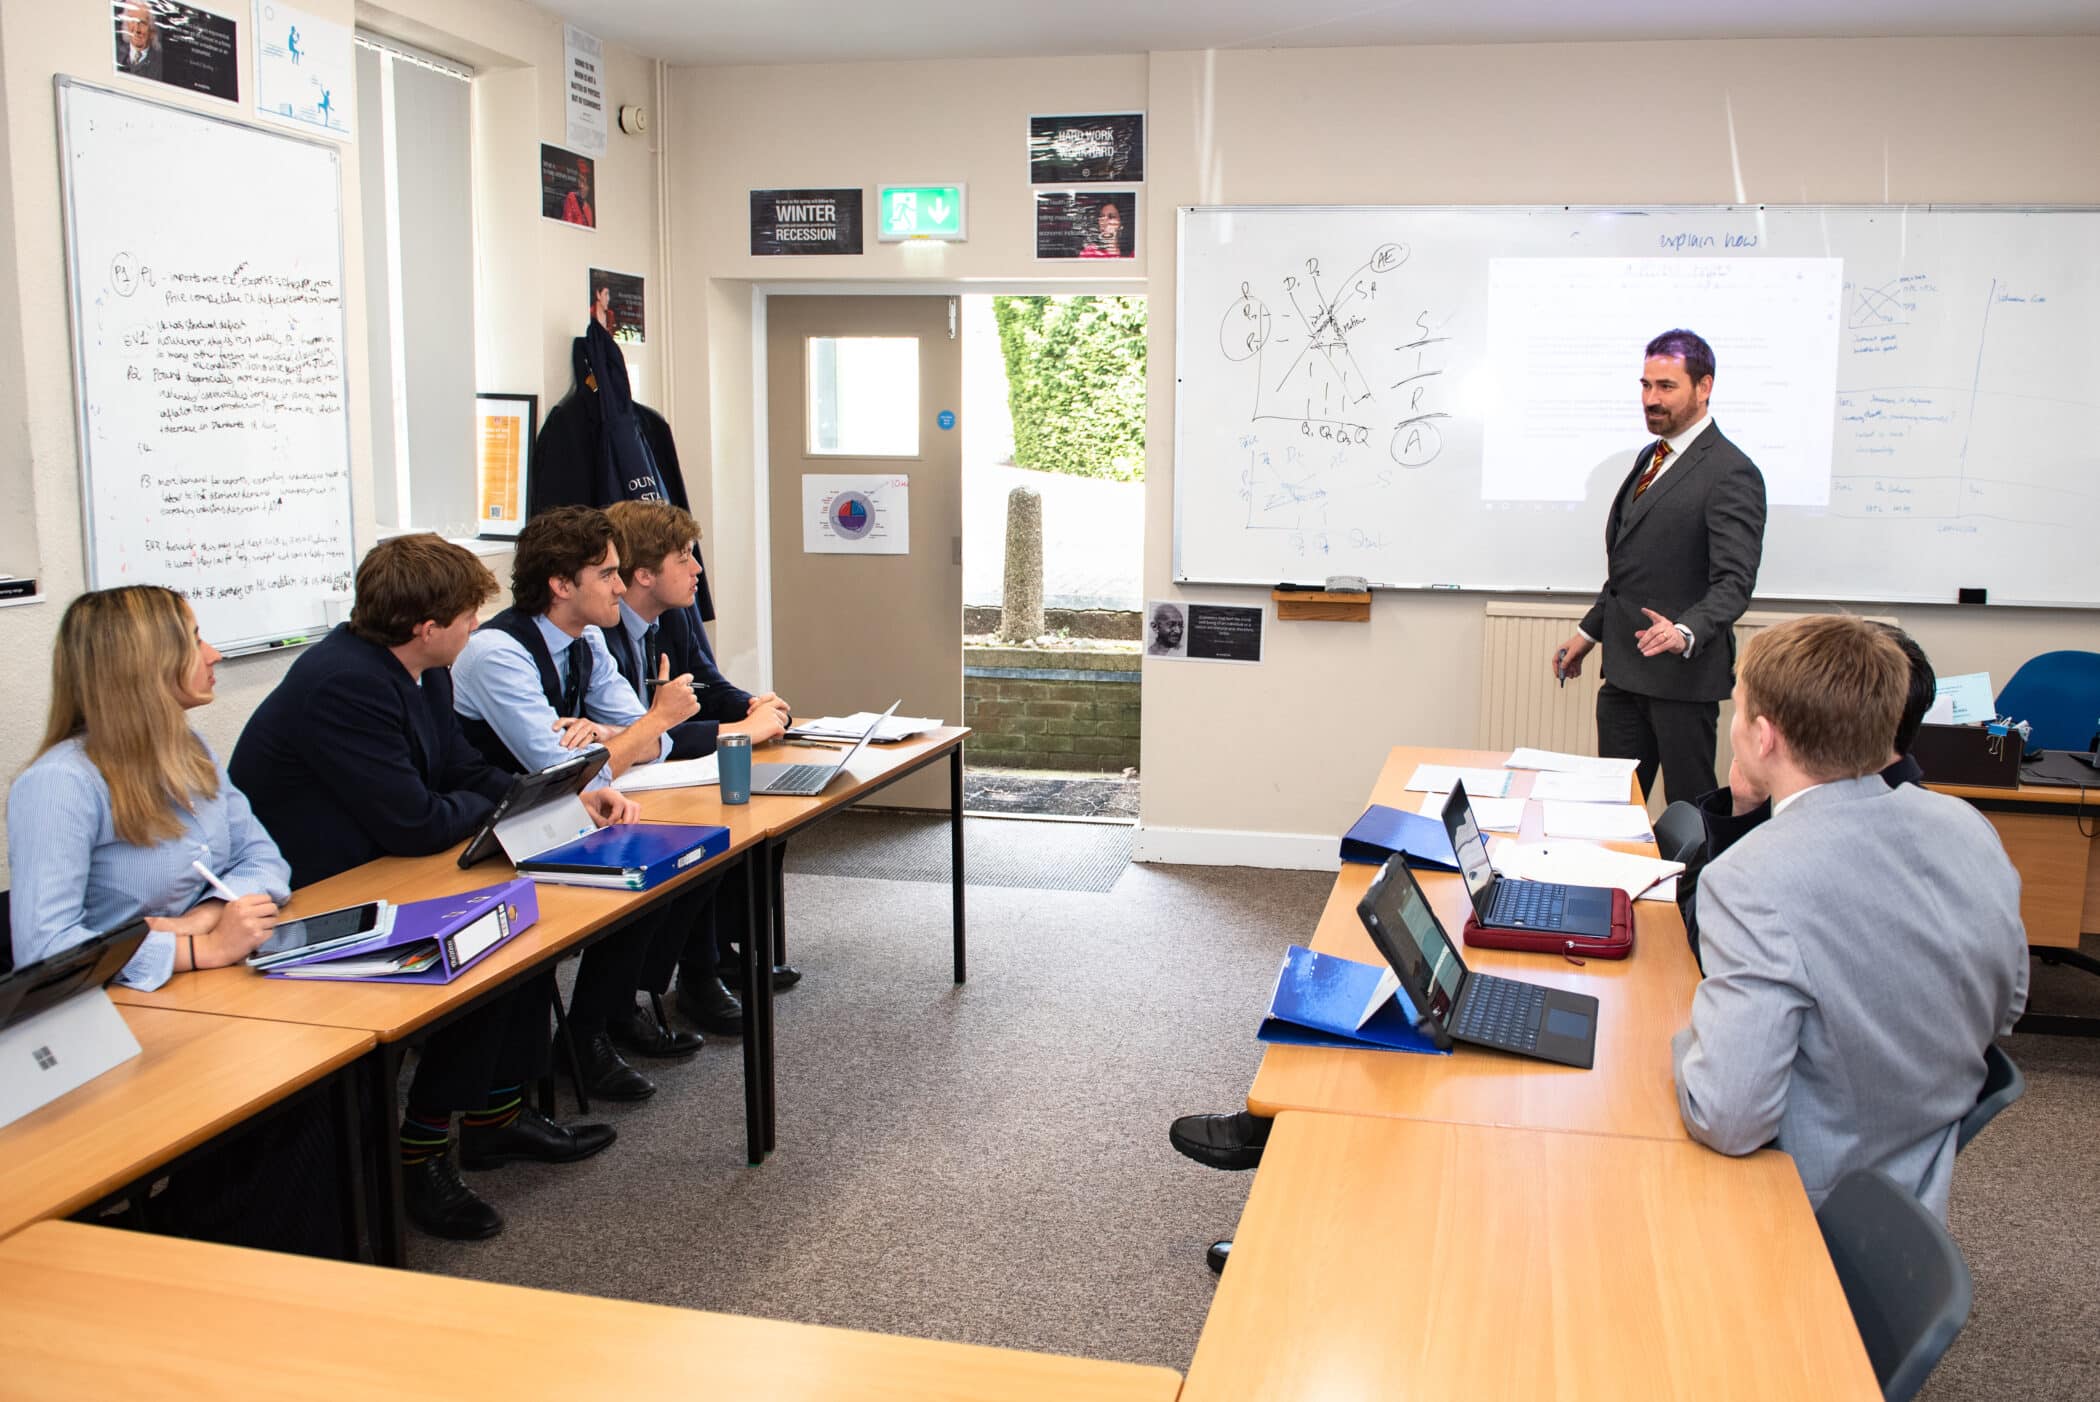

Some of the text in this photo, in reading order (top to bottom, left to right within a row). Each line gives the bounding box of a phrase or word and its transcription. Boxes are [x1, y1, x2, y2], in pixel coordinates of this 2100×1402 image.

[1086, 129, 1114, 141] WORK
[776, 205, 836, 222] WINTER
[776, 229, 836, 241] RECESSION
[1658, 232, 1758, 251] explain how
[1416, 309, 1429, 340] S
[1405, 428, 1422, 454] A
